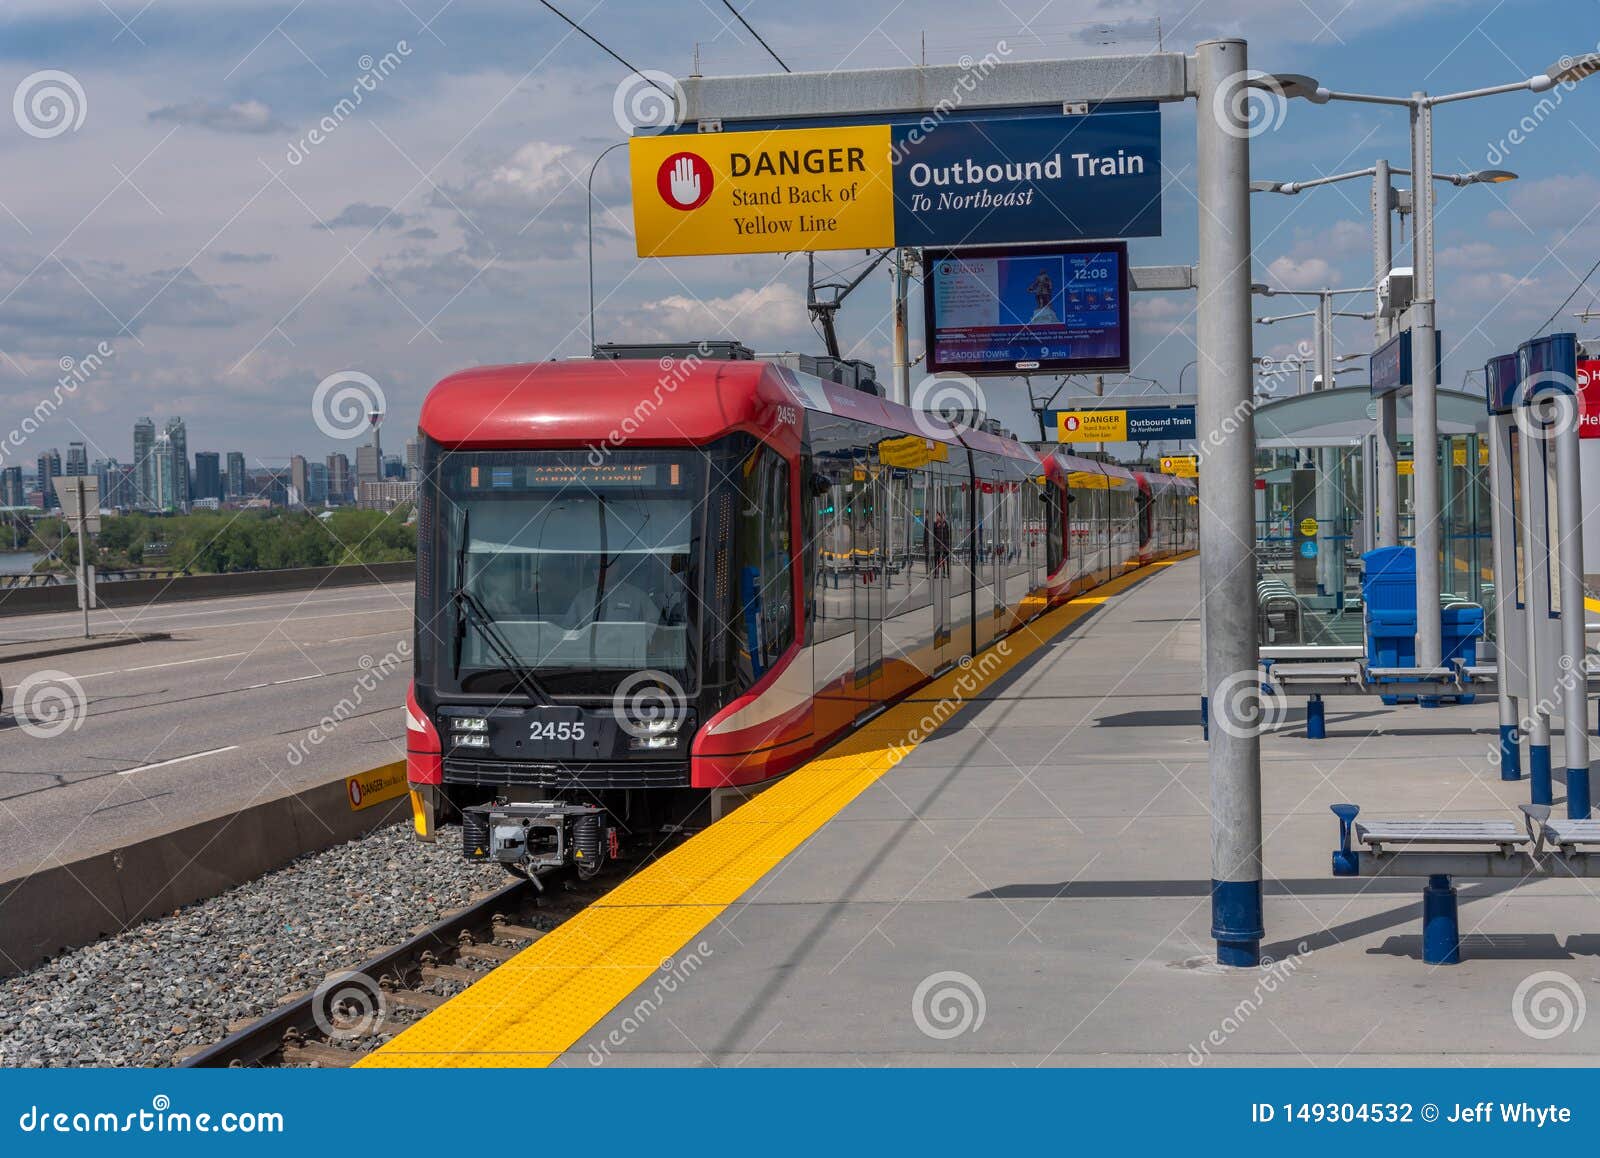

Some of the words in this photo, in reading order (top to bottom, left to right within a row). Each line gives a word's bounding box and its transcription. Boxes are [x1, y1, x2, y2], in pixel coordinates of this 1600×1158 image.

[730, 147, 866, 178] DANGER
[909, 153, 1062, 187] Outbound
[1072, 149, 1144, 178] Train
[732, 186, 782, 206] Stand
[788, 184, 833, 204] Back
[840, 182, 858, 202] of
[911, 194, 931, 212] To
[937, 188, 1034, 211] Northeast
[733, 216, 793, 235] Yellow
[800, 215, 837, 232] Line
[1074, 268, 1108, 279] 12:08
[951, 349, 1010, 360] SADDLETOWNE
[1040, 346, 1049, 358] 9
[1052, 350, 1067, 358] min
[777, 404, 797, 425] 2455
[1130, 418, 1171, 427] Outbound
[1172, 417, 1192, 425] Train
[529, 721, 585, 741] 2455
[361, 779, 383, 796] DANGER
